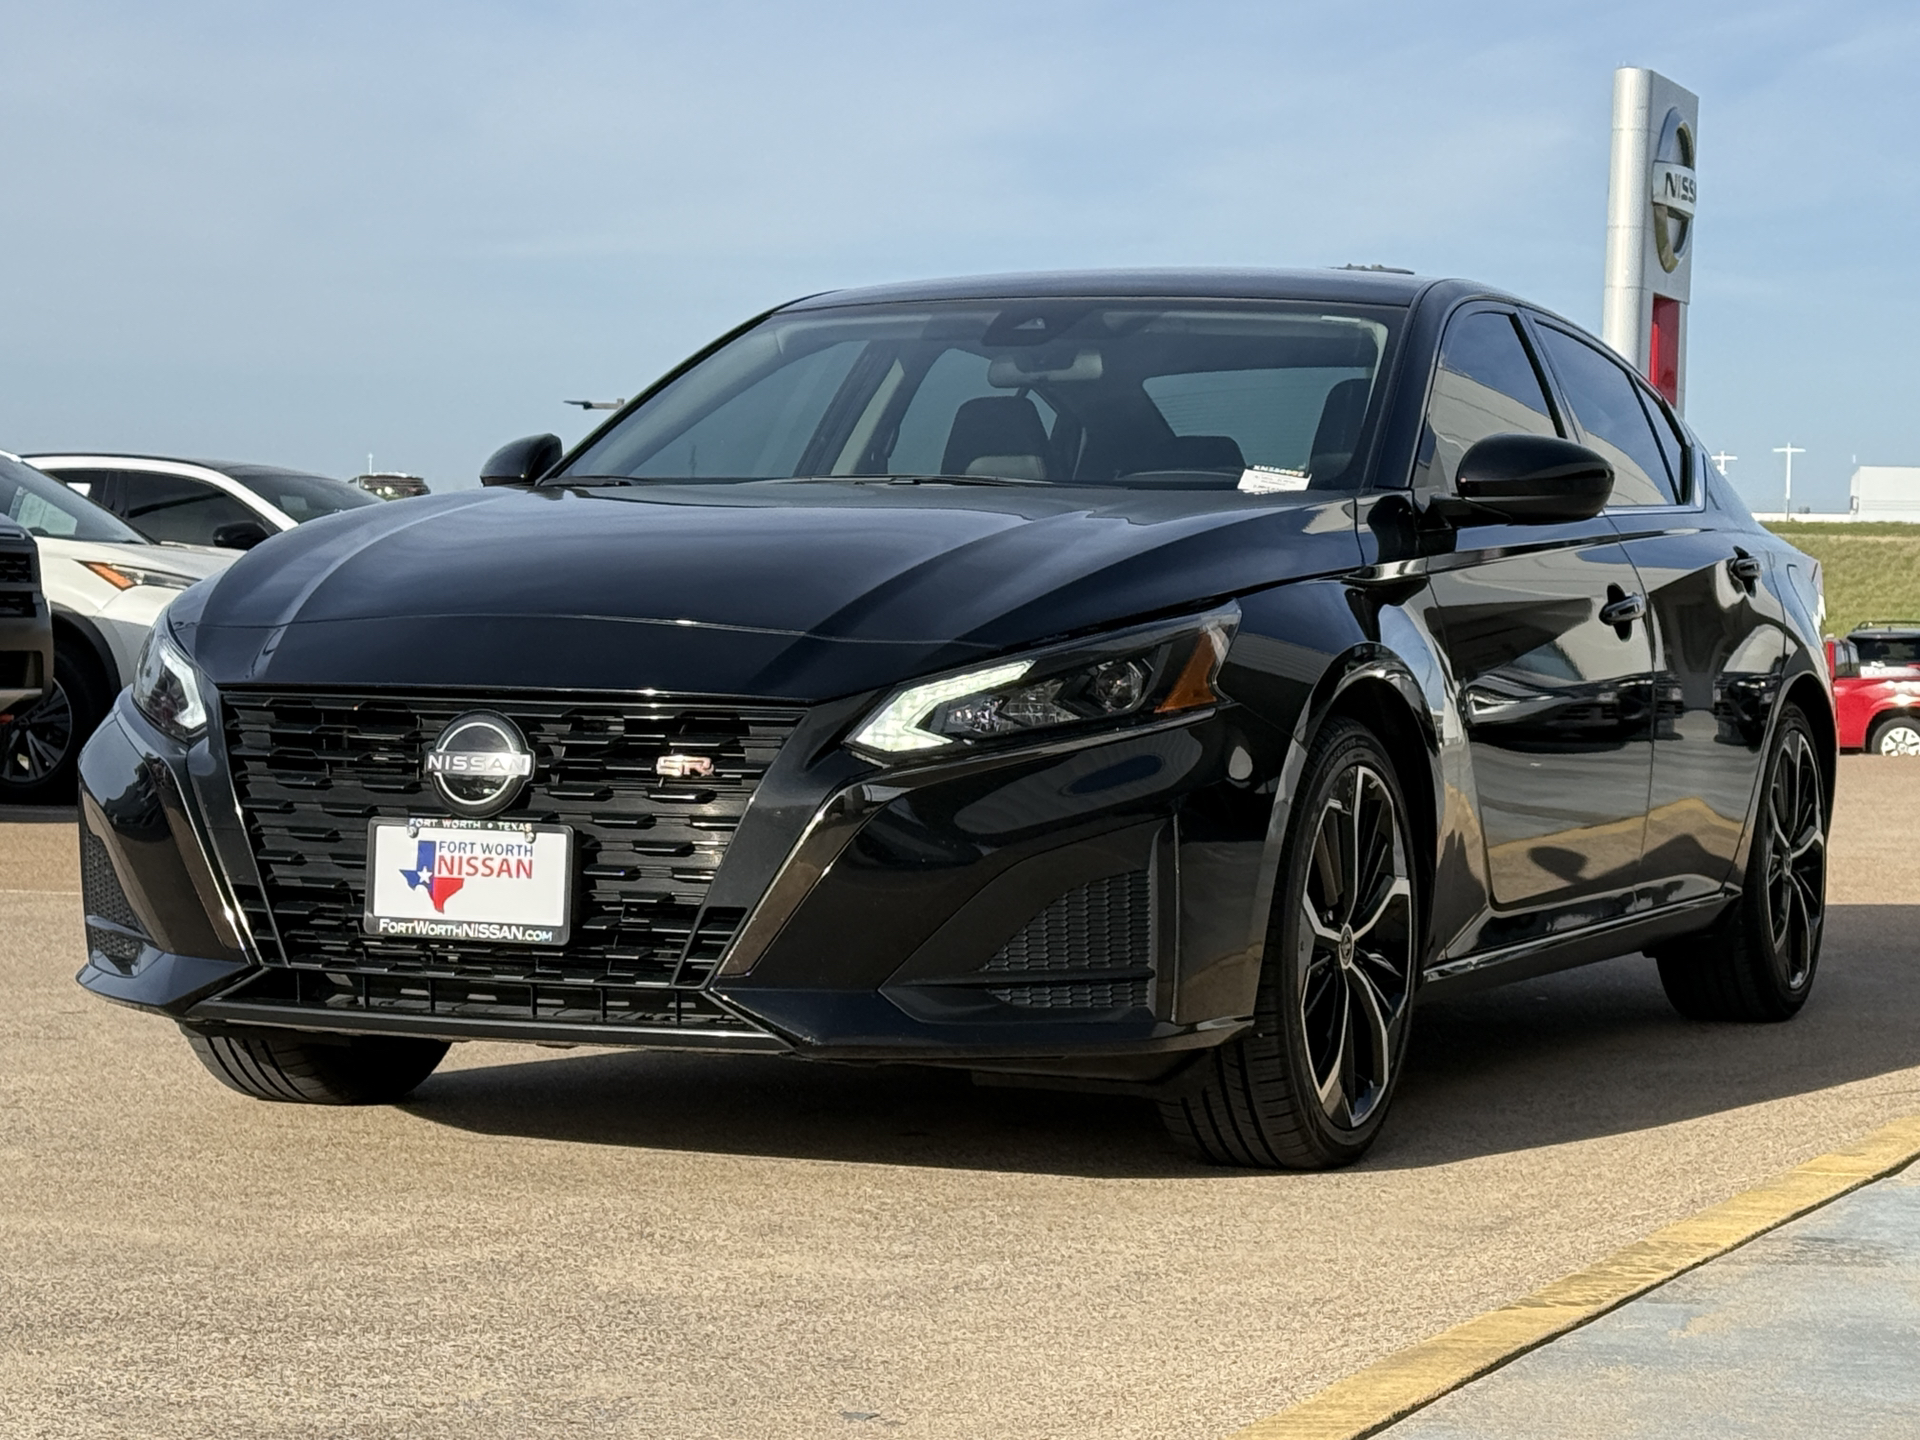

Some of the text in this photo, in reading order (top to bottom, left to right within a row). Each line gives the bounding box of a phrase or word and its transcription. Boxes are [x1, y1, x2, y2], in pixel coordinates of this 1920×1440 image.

[428, 753, 527, 774] NISSAN
[656, 755, 716, 777] SR
[409, 818, 533, 832] FORT WORTH TEXAS
[438, 841, 533, 857] FORT WORTH
[437, 855, 533, 879] NISSAN
